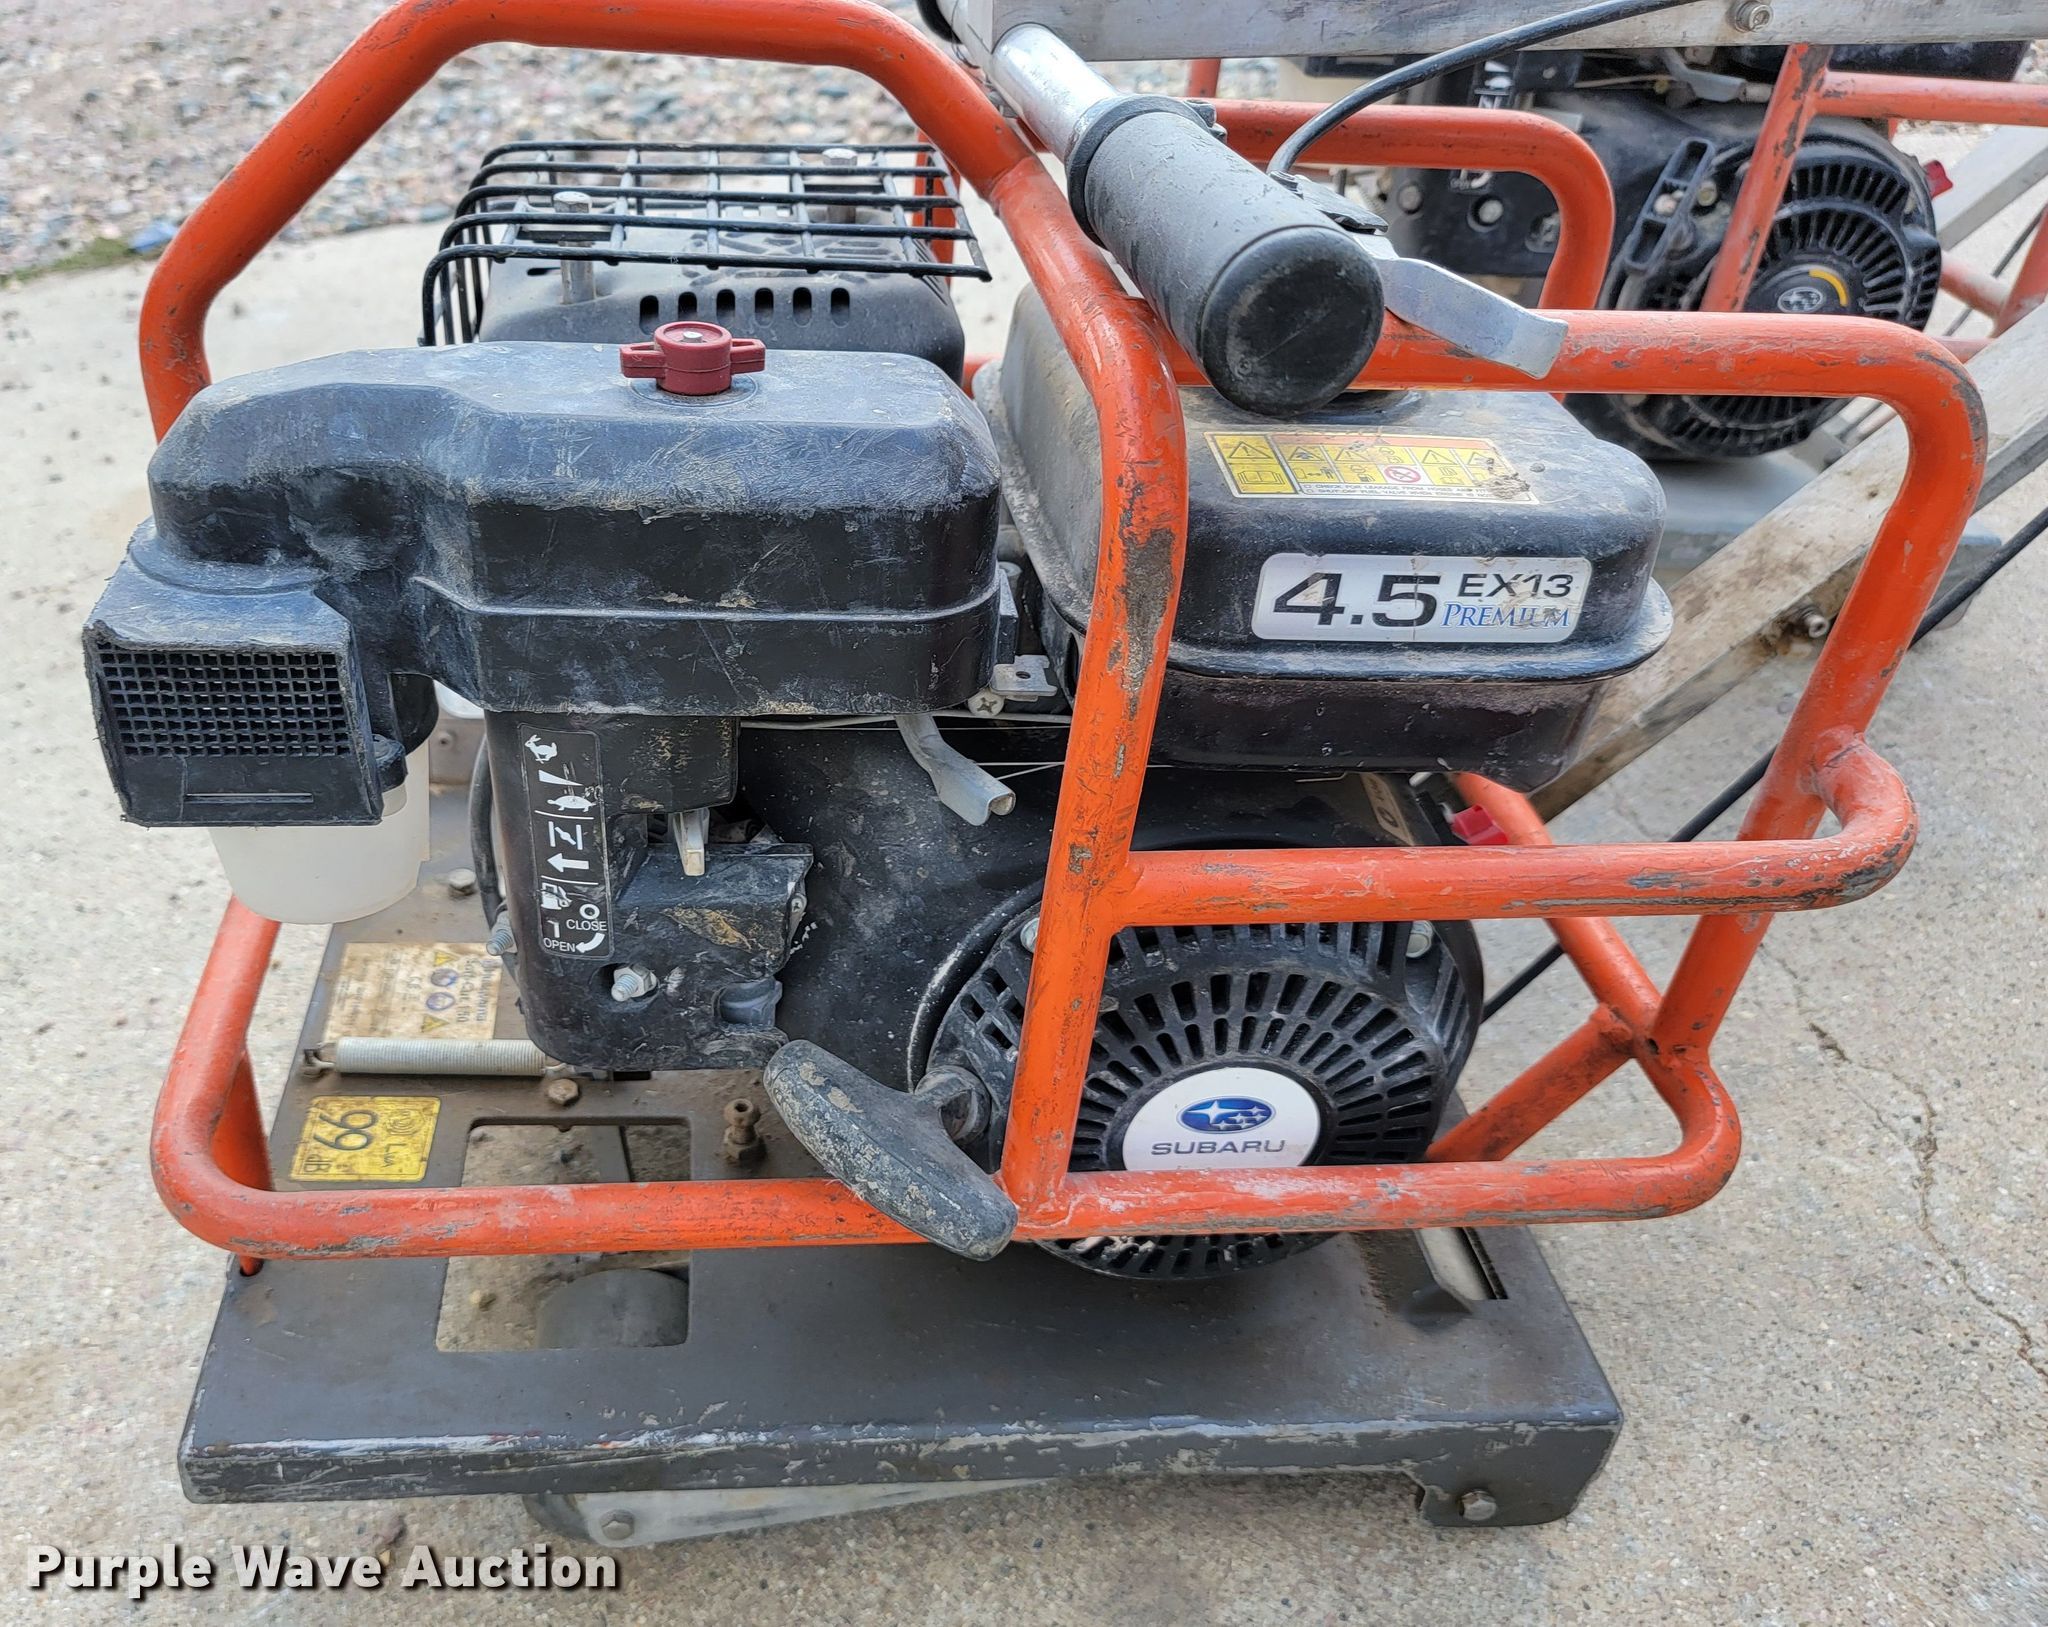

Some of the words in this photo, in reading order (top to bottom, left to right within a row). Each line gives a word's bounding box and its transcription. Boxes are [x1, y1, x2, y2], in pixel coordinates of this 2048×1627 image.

[1458, 573, 1573, 598] EX13
[1272, 572, 1441, 628] 4.5
[1441, 602, 1569, 628] PREMIUM
[566, 918, 608, 932] CLOSE
[543, 937, 576, 953] OPEN
[313, 1110, 377, 1151] 99
[1150, 1139, 1286, 1156] SUBARU
[303, 1153, 333, 1173] dB
